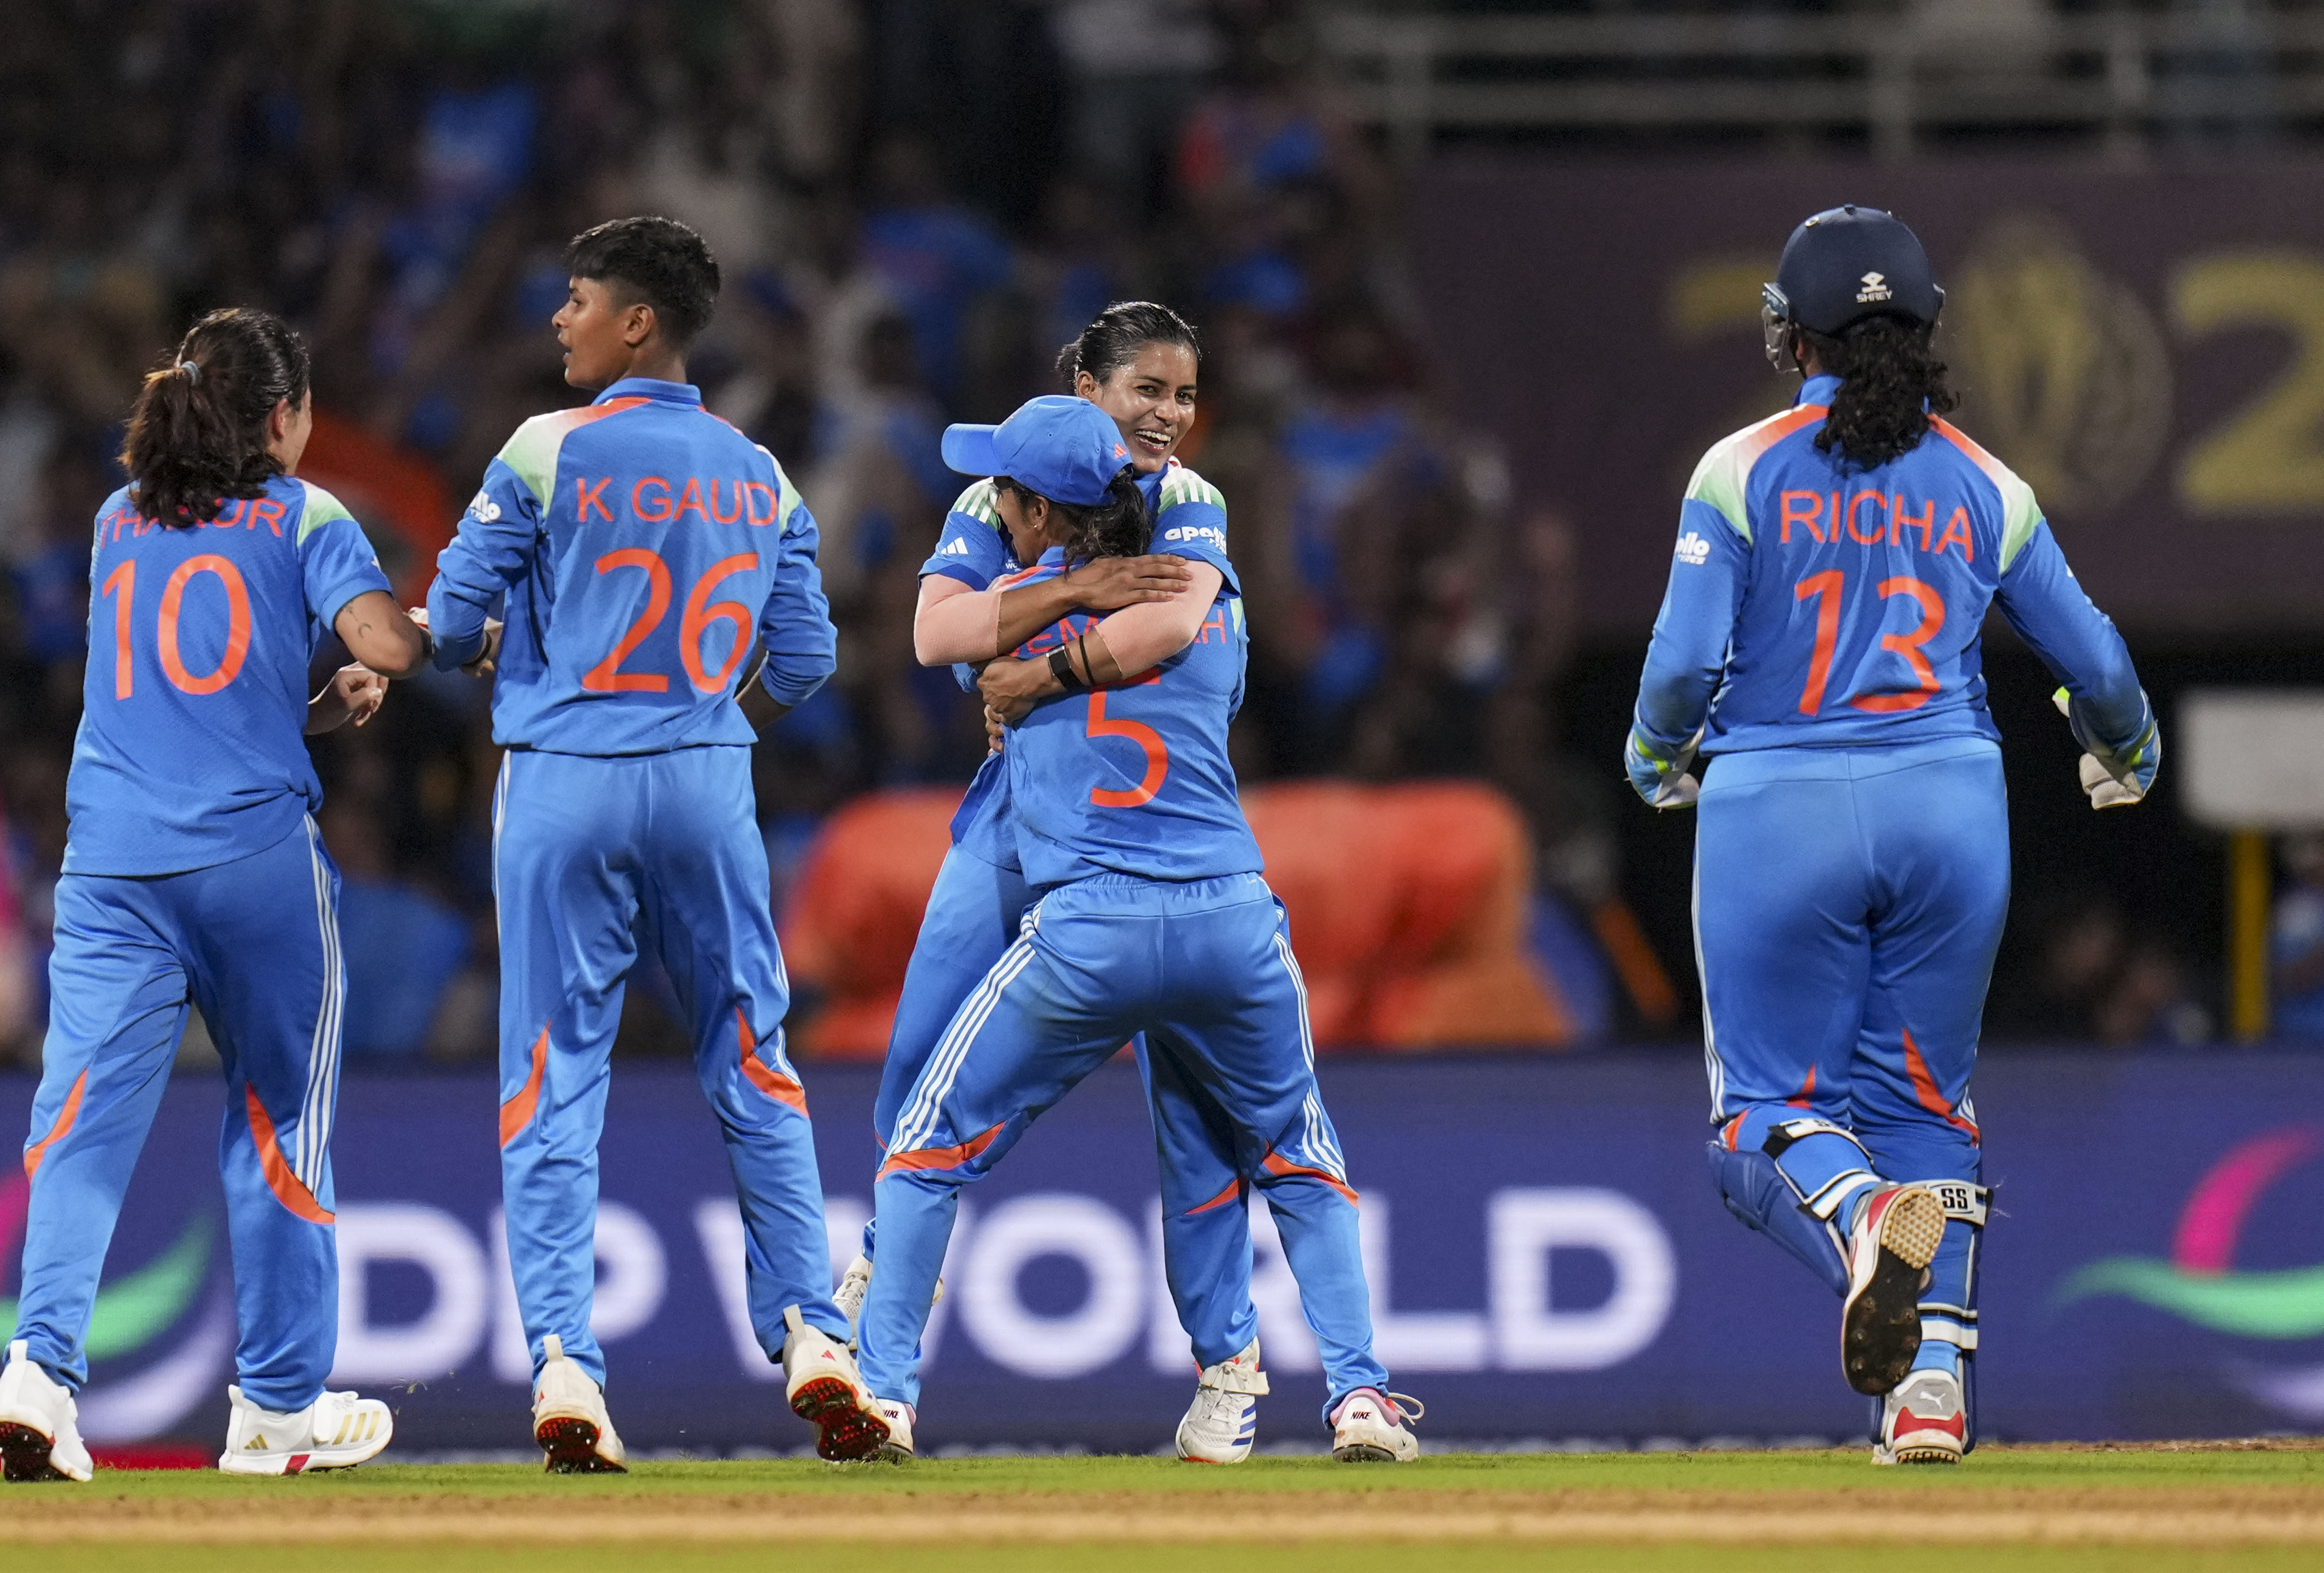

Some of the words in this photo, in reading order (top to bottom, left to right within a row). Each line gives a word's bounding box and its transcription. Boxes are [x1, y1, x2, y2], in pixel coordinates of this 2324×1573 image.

[101, 498, 287, 548] THUR
[577, 477, 614, 522] K
[631, 476, 778, 526] GAUD
[1779, 489, 1973, 563] RICHA
[102, 554, 251, 701] 10
[582, 548, 758, 694] 26
[1795, 569, 1946, 716] 13
[1086, 668, 1168, 807] 5
[1941, 1188, 1968, 1209] SS
[328, 1203, 668, 1384] DP
[1350, 1411, 1371, 1420] NIKE
